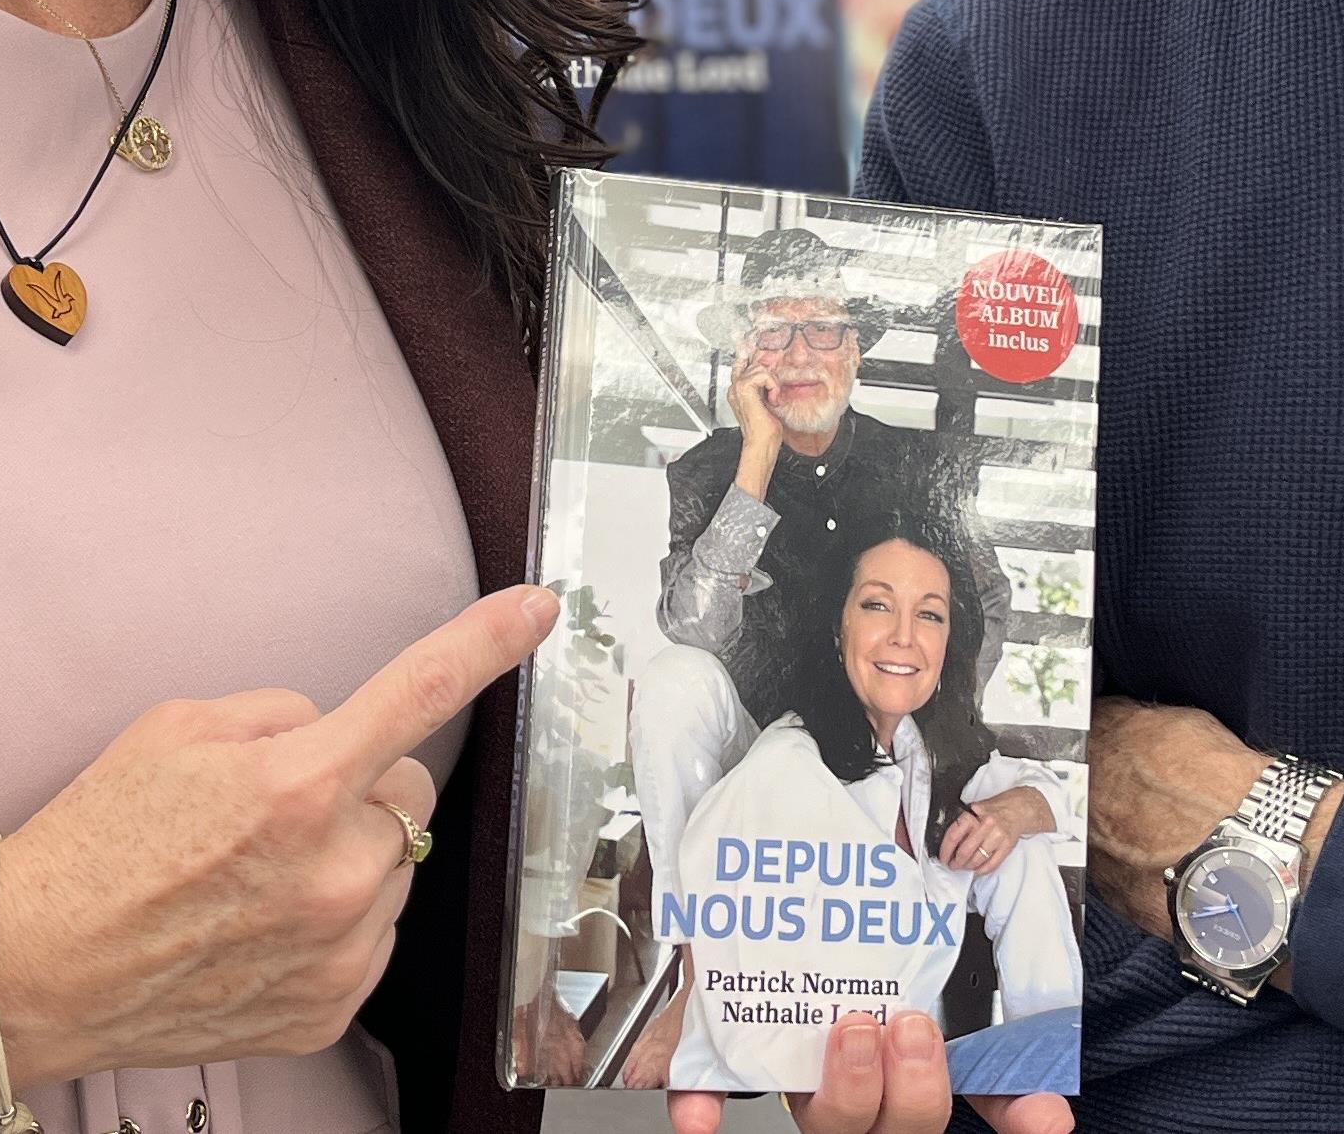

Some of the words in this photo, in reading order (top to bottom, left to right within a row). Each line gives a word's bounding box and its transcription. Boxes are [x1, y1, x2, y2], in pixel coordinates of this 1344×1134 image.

[970, 278, 1064, 307] NOUVEL
[978, 303, 1061, 330] ALBUM
[987, 328, 1051, 353] inclus
[515, 662, 528, 743] NOU
[716, 837, 897, 888] DEPUIS
[659, 892, 806, 942] NOUS
[821, 898, 958, 947] DEUX
[705, 969, 795, 993] Patrick
[801, 972, 900, 996] Norman
[721, 1000, 824, 1025] Nathalie
